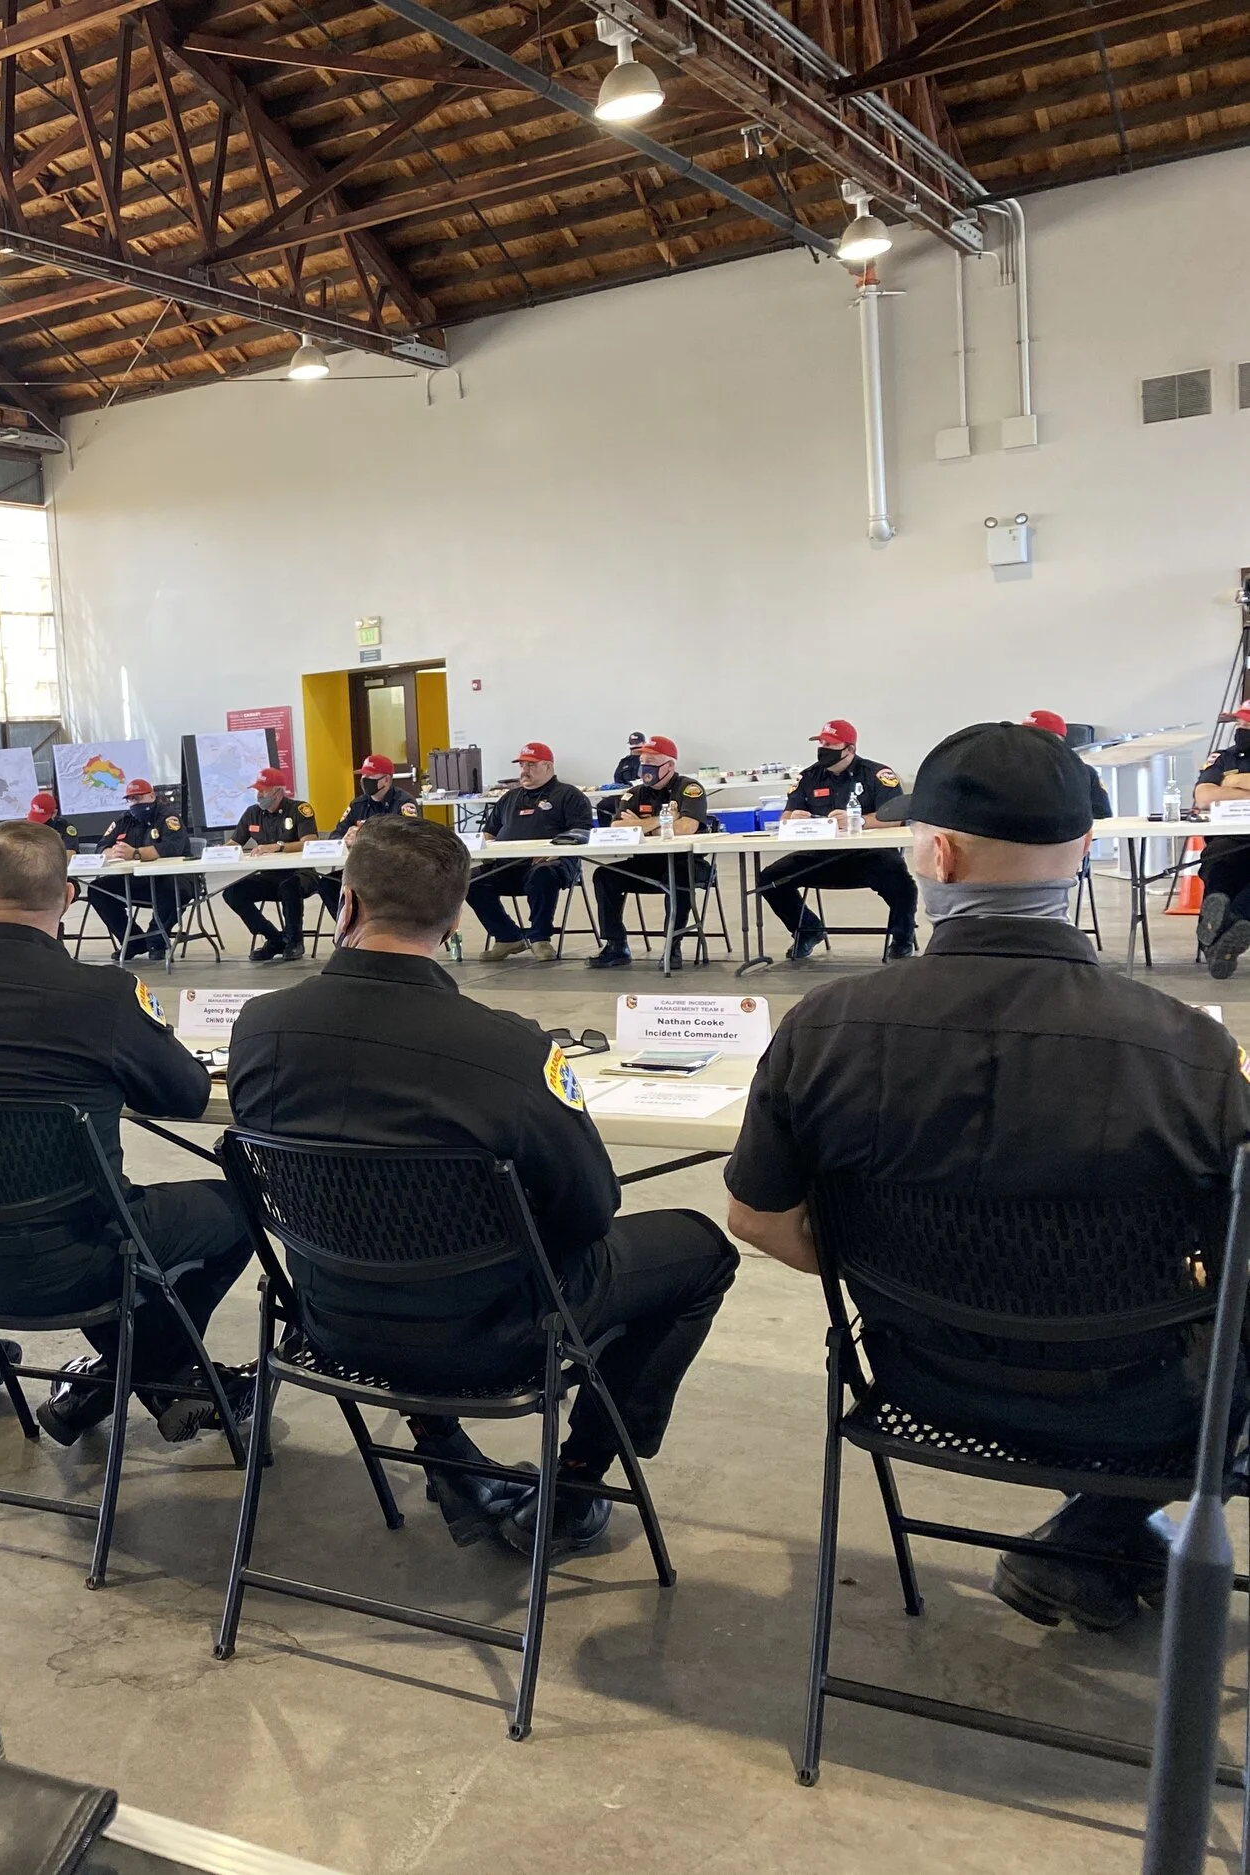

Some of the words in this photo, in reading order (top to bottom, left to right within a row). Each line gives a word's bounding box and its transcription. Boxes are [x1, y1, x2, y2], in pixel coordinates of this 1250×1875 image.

[657, 1018, 691, 1026] Nathan
[694, 1018, 725, 1026] Cooke
[645, 1029, 681, 1037] Incident
[684, 1030, 738, 1039] Commander
